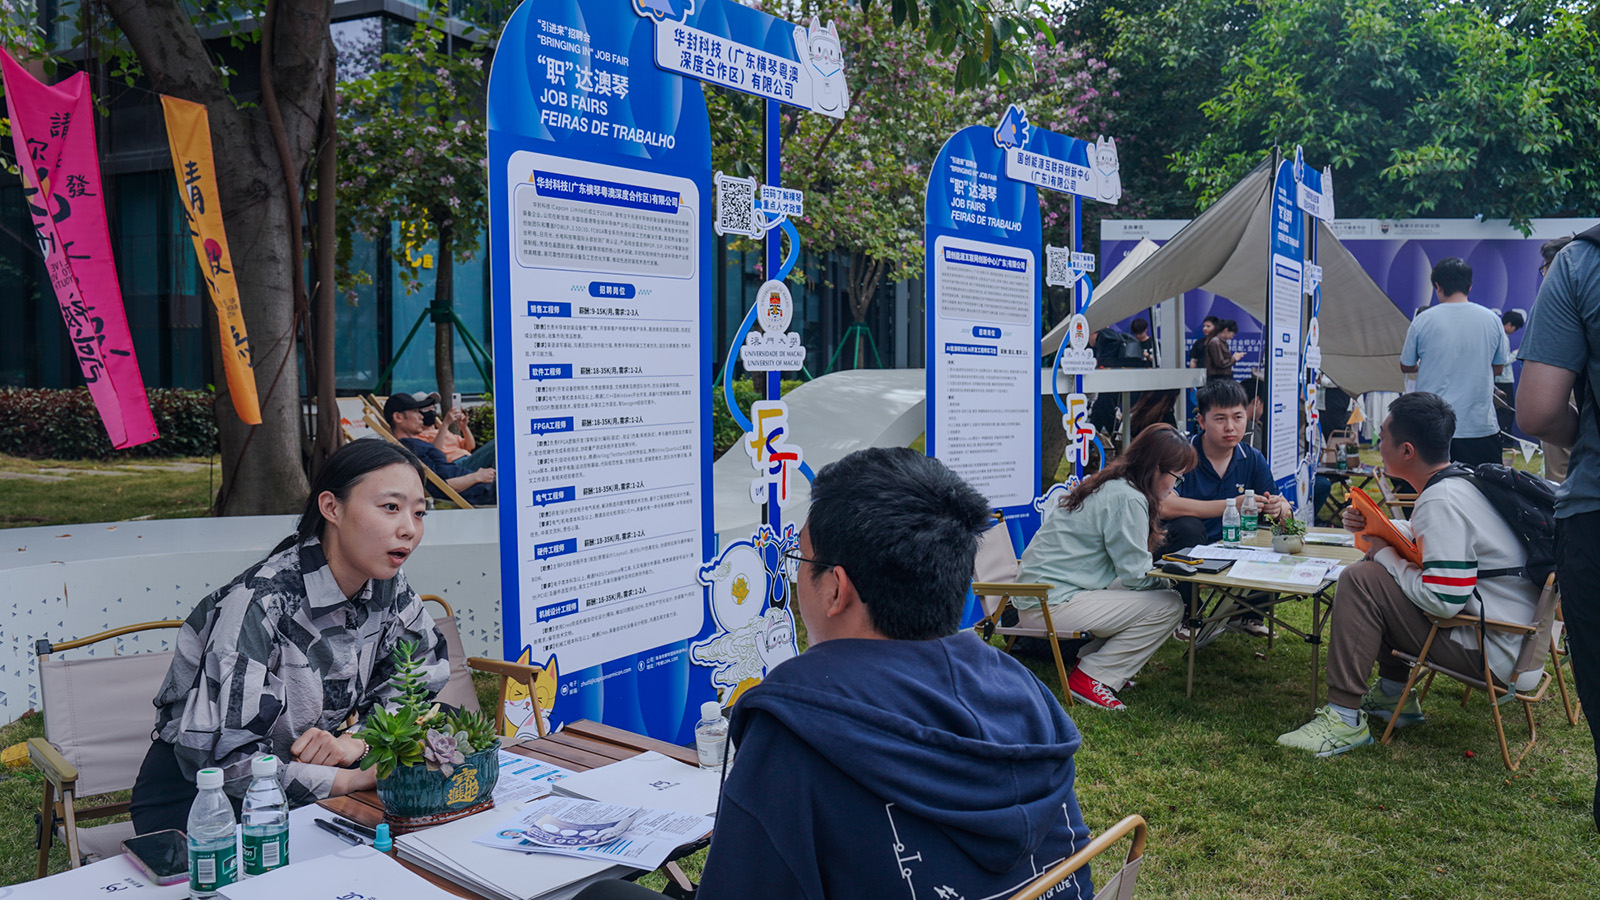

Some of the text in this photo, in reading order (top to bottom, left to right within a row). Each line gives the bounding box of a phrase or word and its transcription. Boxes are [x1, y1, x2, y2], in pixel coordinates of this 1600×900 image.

[595, 49, 611, 62] JOB
[612, 53, 629, 67] FAIR
[540, 88, 608, 116] JOB FAIRS
[541, 109, 676, 150] FEIRAS DE TRABALHO
[979, 171, 988, 179] JOB
[988, 173, 997, 182] FAIR
[951, 197, 986, 212] JOB FAIRS
[951, 210, 1022, 232] FEIRAS DE TRABALHO
